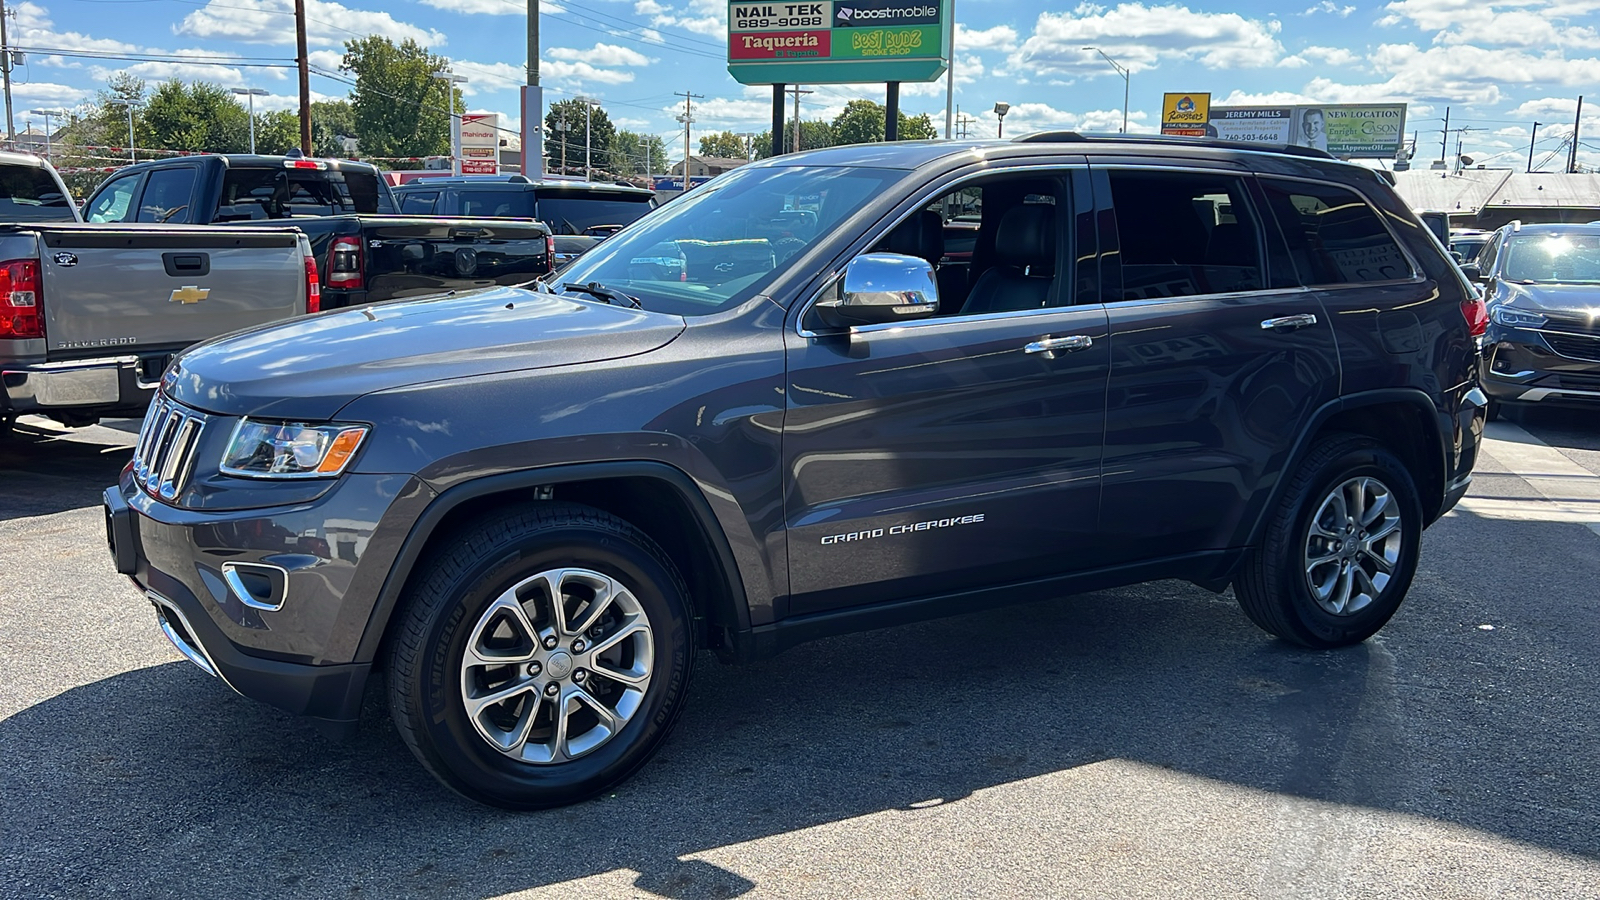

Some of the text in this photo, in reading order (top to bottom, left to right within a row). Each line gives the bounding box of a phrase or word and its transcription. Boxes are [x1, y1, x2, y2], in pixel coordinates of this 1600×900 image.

[736, 4, 823, 18] NAIL TEK
[854, 6, 937, 19] boostmobile
[738, 17, 822, 28] 689-9088
[889, 48, 910, 56] SHOP
[1167, 112, 1203, 121] Roosters
[1329, 128, 1357, 136] Enright
[1362, 121, 1397, 134] CASON
[59, 337, 137, 348] SILVERADO
[821, 513, 985, 545] GRAND CHEROKEE
[432, 604, 463, 686] MICHELIN
[656, 651, 684, 724] MICHELIN
